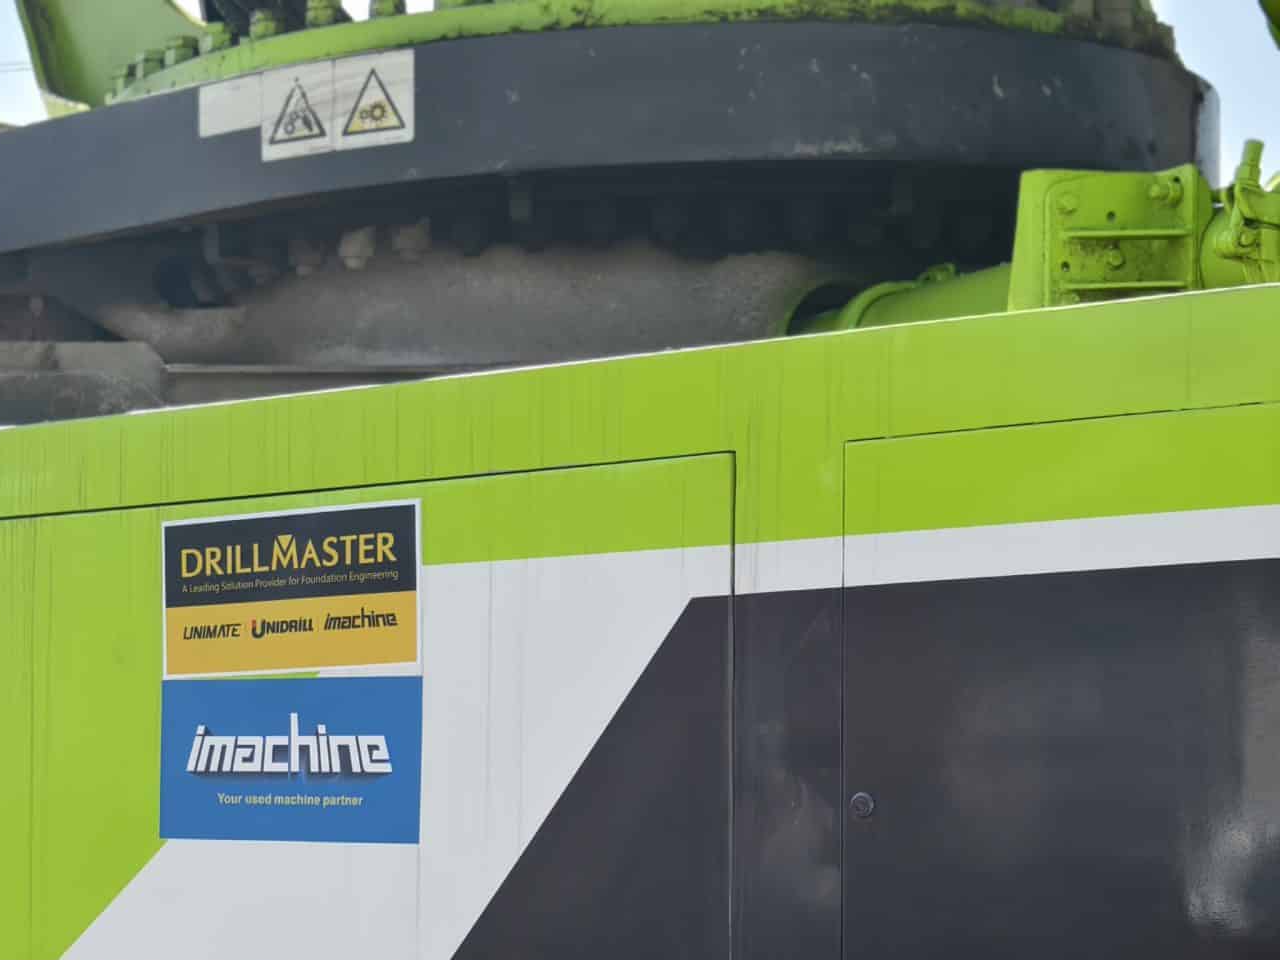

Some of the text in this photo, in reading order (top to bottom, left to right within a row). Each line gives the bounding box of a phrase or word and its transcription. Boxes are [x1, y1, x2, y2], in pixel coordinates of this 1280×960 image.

[180, 533, 397, 579] DRILLMASTER
[189, 583, 220, 594] Leading
[221, 581, 253, 592] Solution
[254, 578, 287, 589] Provider
[288, 577, 300, 586] for
[301, 574, 347, 585] Foundation
[348, 569, 399, 582] Engineering
[183, 623, 241, 640] UNIMATE
[324, 607, 399, 631] imachine
[186, 712, 393, 774] imachine
[217, 793, 363, 808] Your used machine partner
